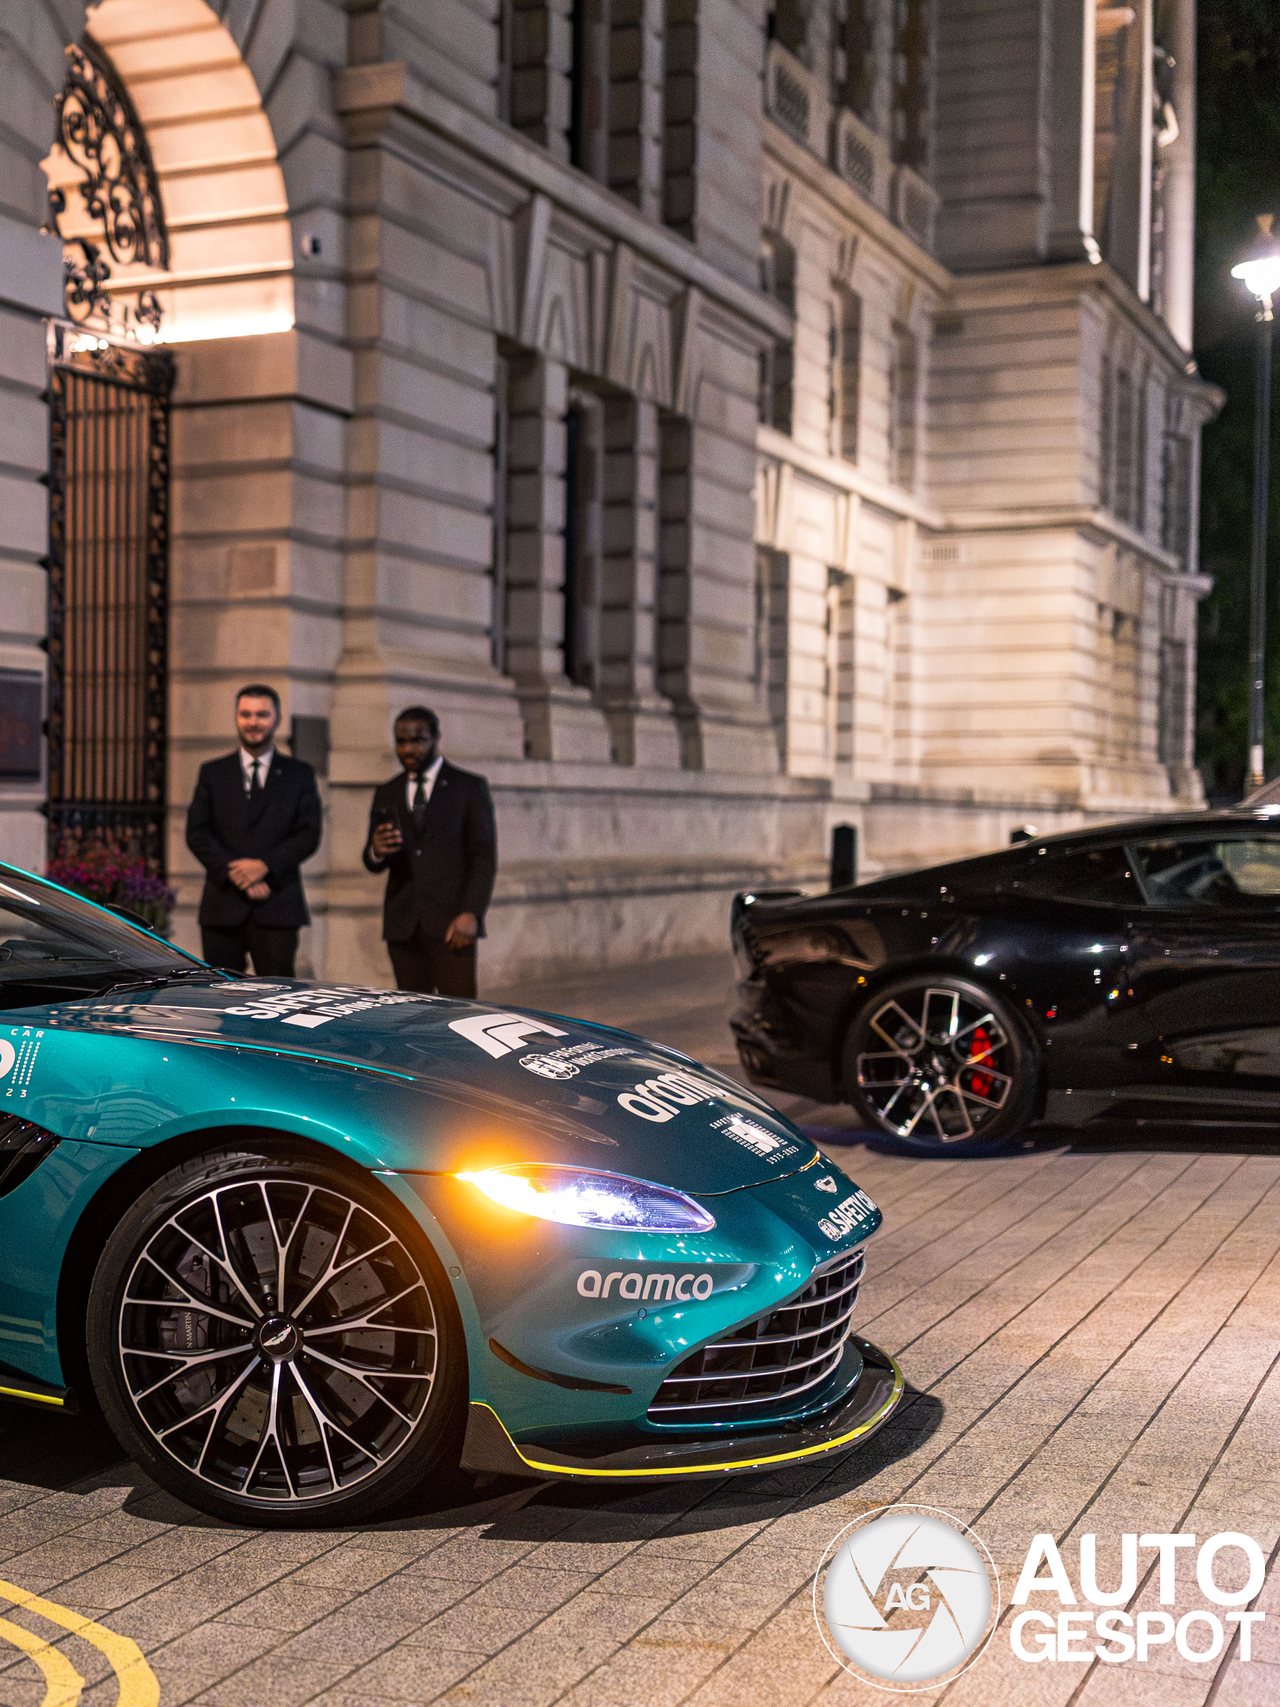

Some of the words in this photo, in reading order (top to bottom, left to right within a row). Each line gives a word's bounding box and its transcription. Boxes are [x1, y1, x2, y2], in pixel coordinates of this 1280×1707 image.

[224, 988, 361, 1020] SAFETY
[11, 1028, 45, 1039] CAR
[828, 1194, 871, 1235] SAFETY
[576, 1269, 714, 1301] aramco
[185, 1312, 194, 1341] MARTIN
